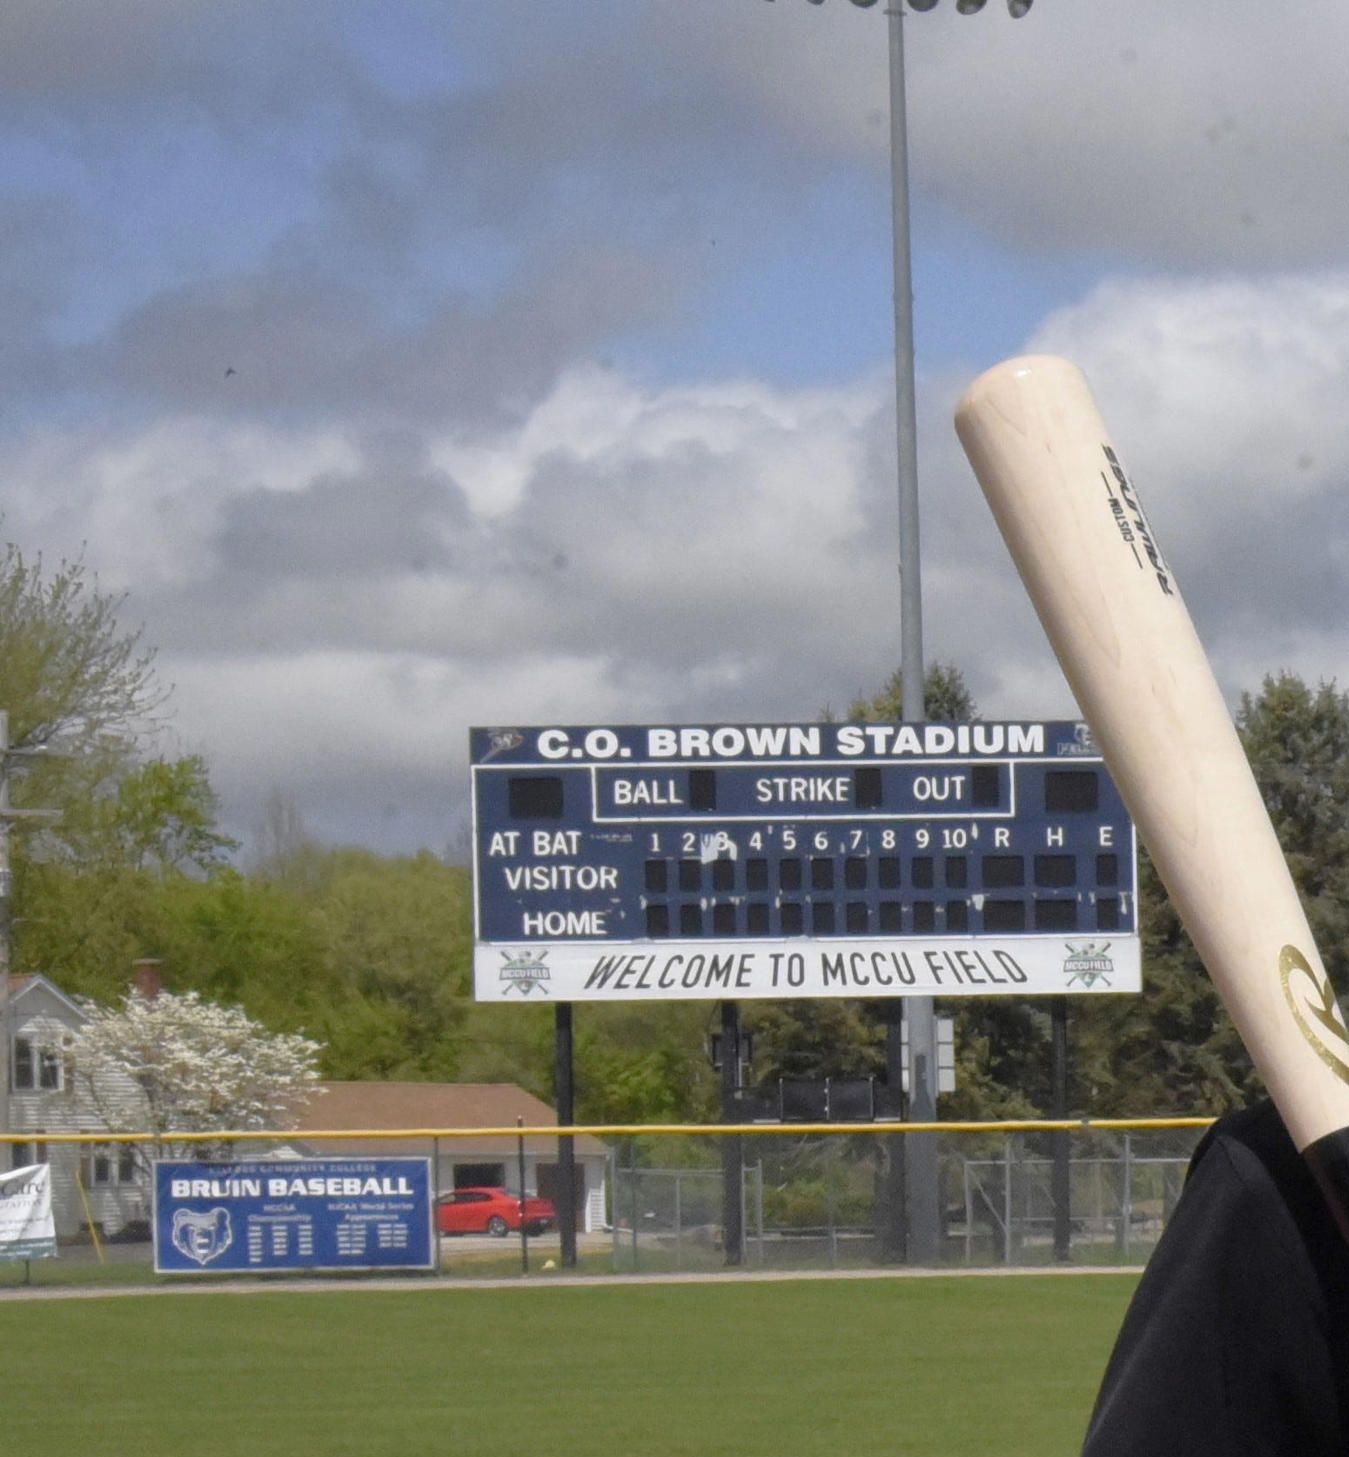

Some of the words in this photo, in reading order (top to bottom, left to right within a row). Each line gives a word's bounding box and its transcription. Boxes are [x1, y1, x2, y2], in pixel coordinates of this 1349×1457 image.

[1107, 498, 1135, 542] CUSTOM
[537, 729, 631, 758] C.O.
[648, 727, 820, 757] BROWN
[836, 725, 1044, 755] STADIUM
[614, 779, 683, 805] BALL
[756, 777, 851, 802] STRIKE
[913, 775, 965, 801] OUT
[489, 831, 521, 856] AT
[533, 830, 582, 855] BAT
[650, 832, 661, 852] 1
[682, 832, 695, 852] 2
[716, 831, 729, 851] 3
[750, 831, 762, 851] 4
[783, 831, 796, 850] 5
[814, 830, 828, 850] 6
[850, 830, 862, 849] 7
[882, 829, 896, 849] 8
[915, 829, 929, 848] 9
[943, 828, 967, 848] 10
[995, 828, 1010, 848] R
[1047, 827, 1063, 846] H
[1100, 826, 1114, 847] E
[505, 866, 618, 892] VISITOR
[523, 911, 607, 936] HOME
[584, 953, 755, 990] WELCOME
[769, 953, 805, 988] TO
[821, 951, 916, 986] MCCU
[923, 950, 1028, 985] FIELD
[171, 1179, 261, 1198] BRUIN
[268, 1177, 414, 1196] BASEBALL
